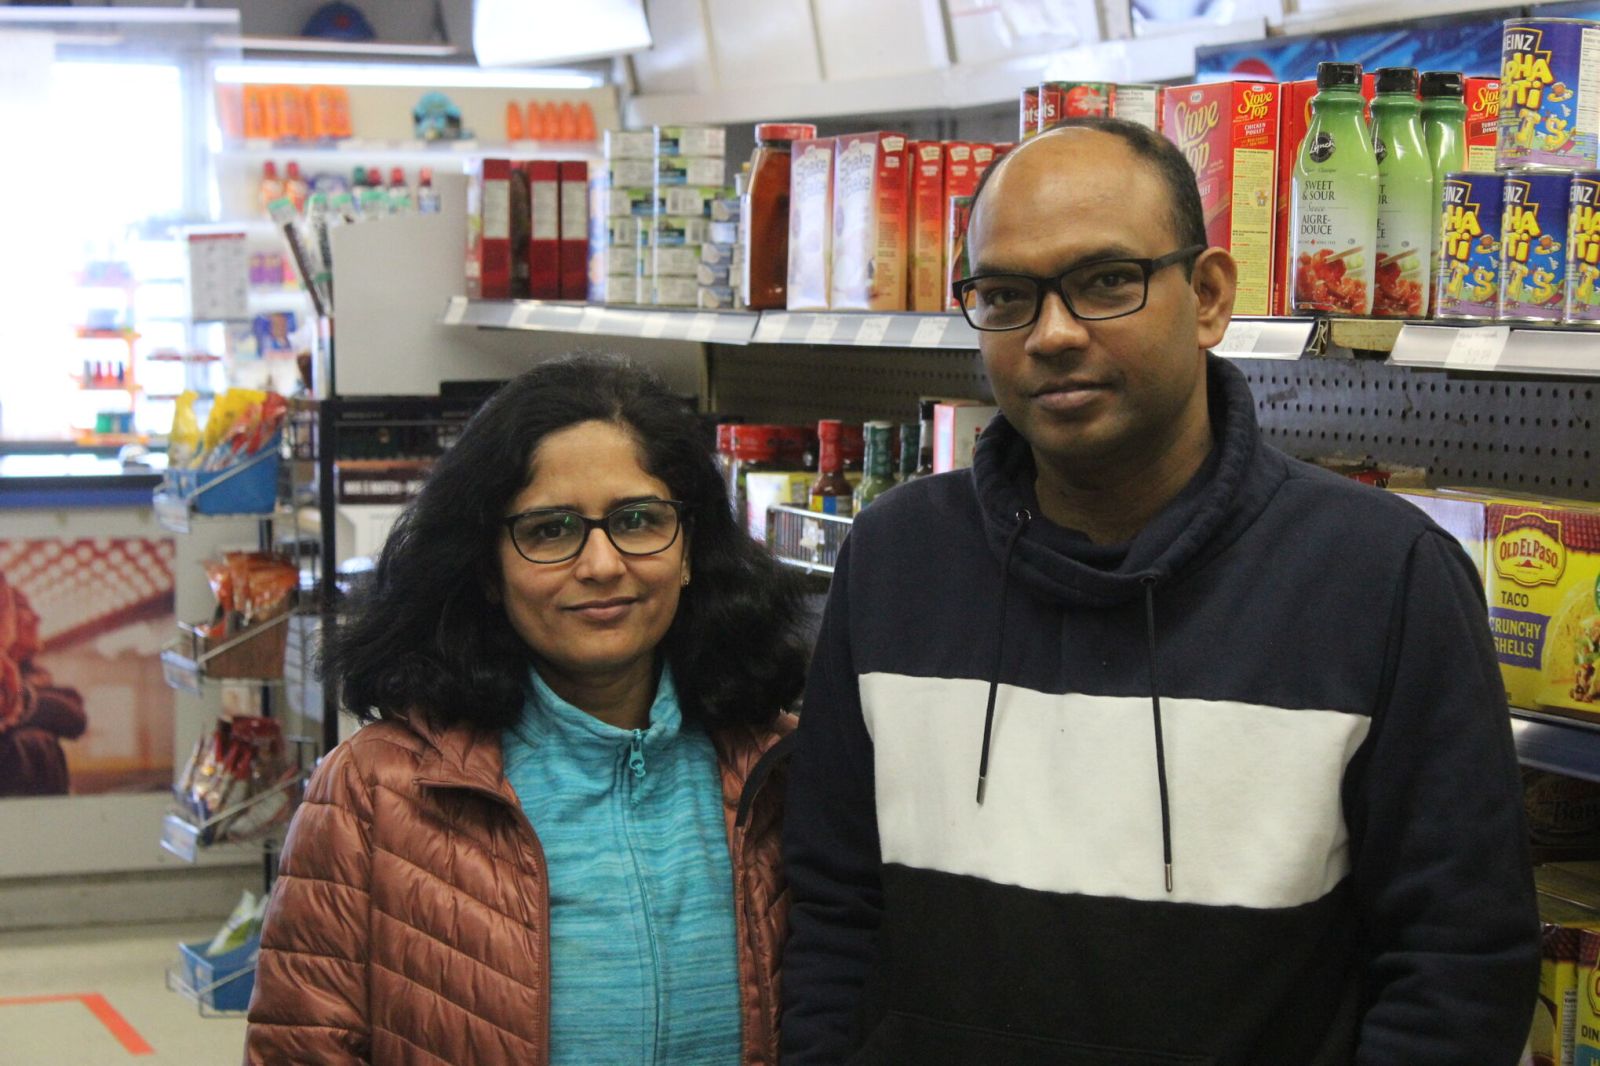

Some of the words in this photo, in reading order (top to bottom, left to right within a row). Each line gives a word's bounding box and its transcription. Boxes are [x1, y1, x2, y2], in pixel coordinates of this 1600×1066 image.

[1503, 34, 1534, 51] EINZ
[1237, 90, 1273, 114] Stove
[1250, 104, 1268, 120] Top
[1174, 100, 1220, 150] Stove
[1304, 180, 1334, 191] SWEET
[1302, 191, 1308, 201] &
[1309, 190, 1336, 201] SOUR
[1302, 214, 1331, 225] AIGRE-
[1300, 224, 1333, 235] DOUCE
[1500, 540, 1519, 561] OLD
[1501, 590, 1530, 608] TACO
[1489, 616, 1542, 640] CRUNCHY
